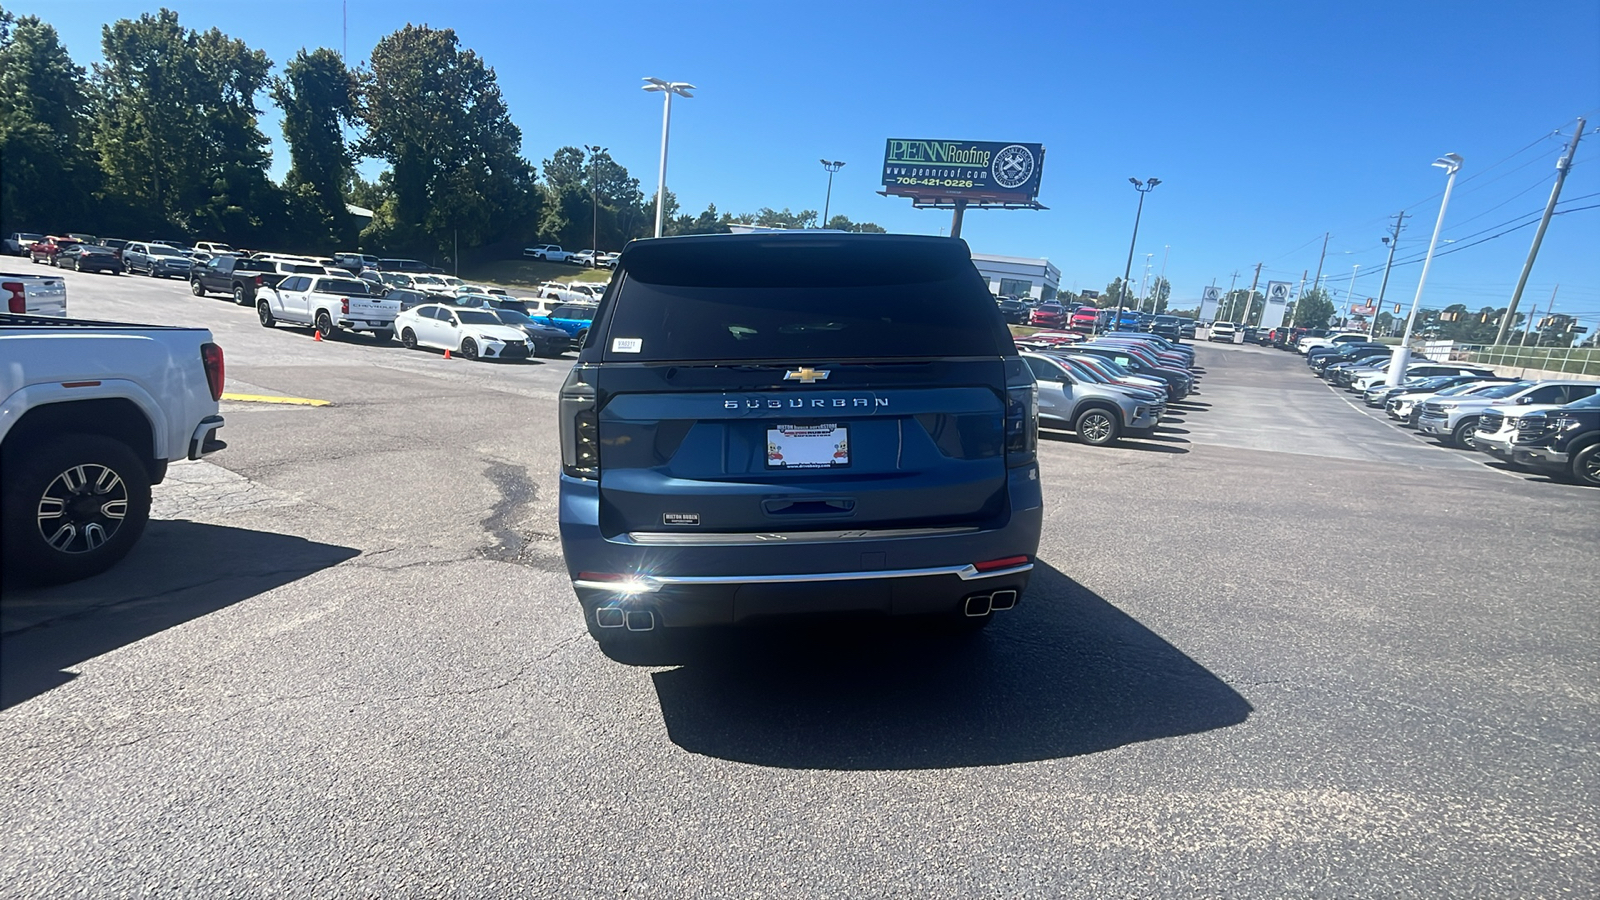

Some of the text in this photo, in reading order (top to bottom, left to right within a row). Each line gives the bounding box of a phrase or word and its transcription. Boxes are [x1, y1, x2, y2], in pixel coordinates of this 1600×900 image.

[888, 140, 991, 168] PENN Roofing
[886, 167, 988, 179] www.pennroof.com
[896, 177, 973, 188] 706-421-0226
[724, 398, 889, 409] SUBURBAN
